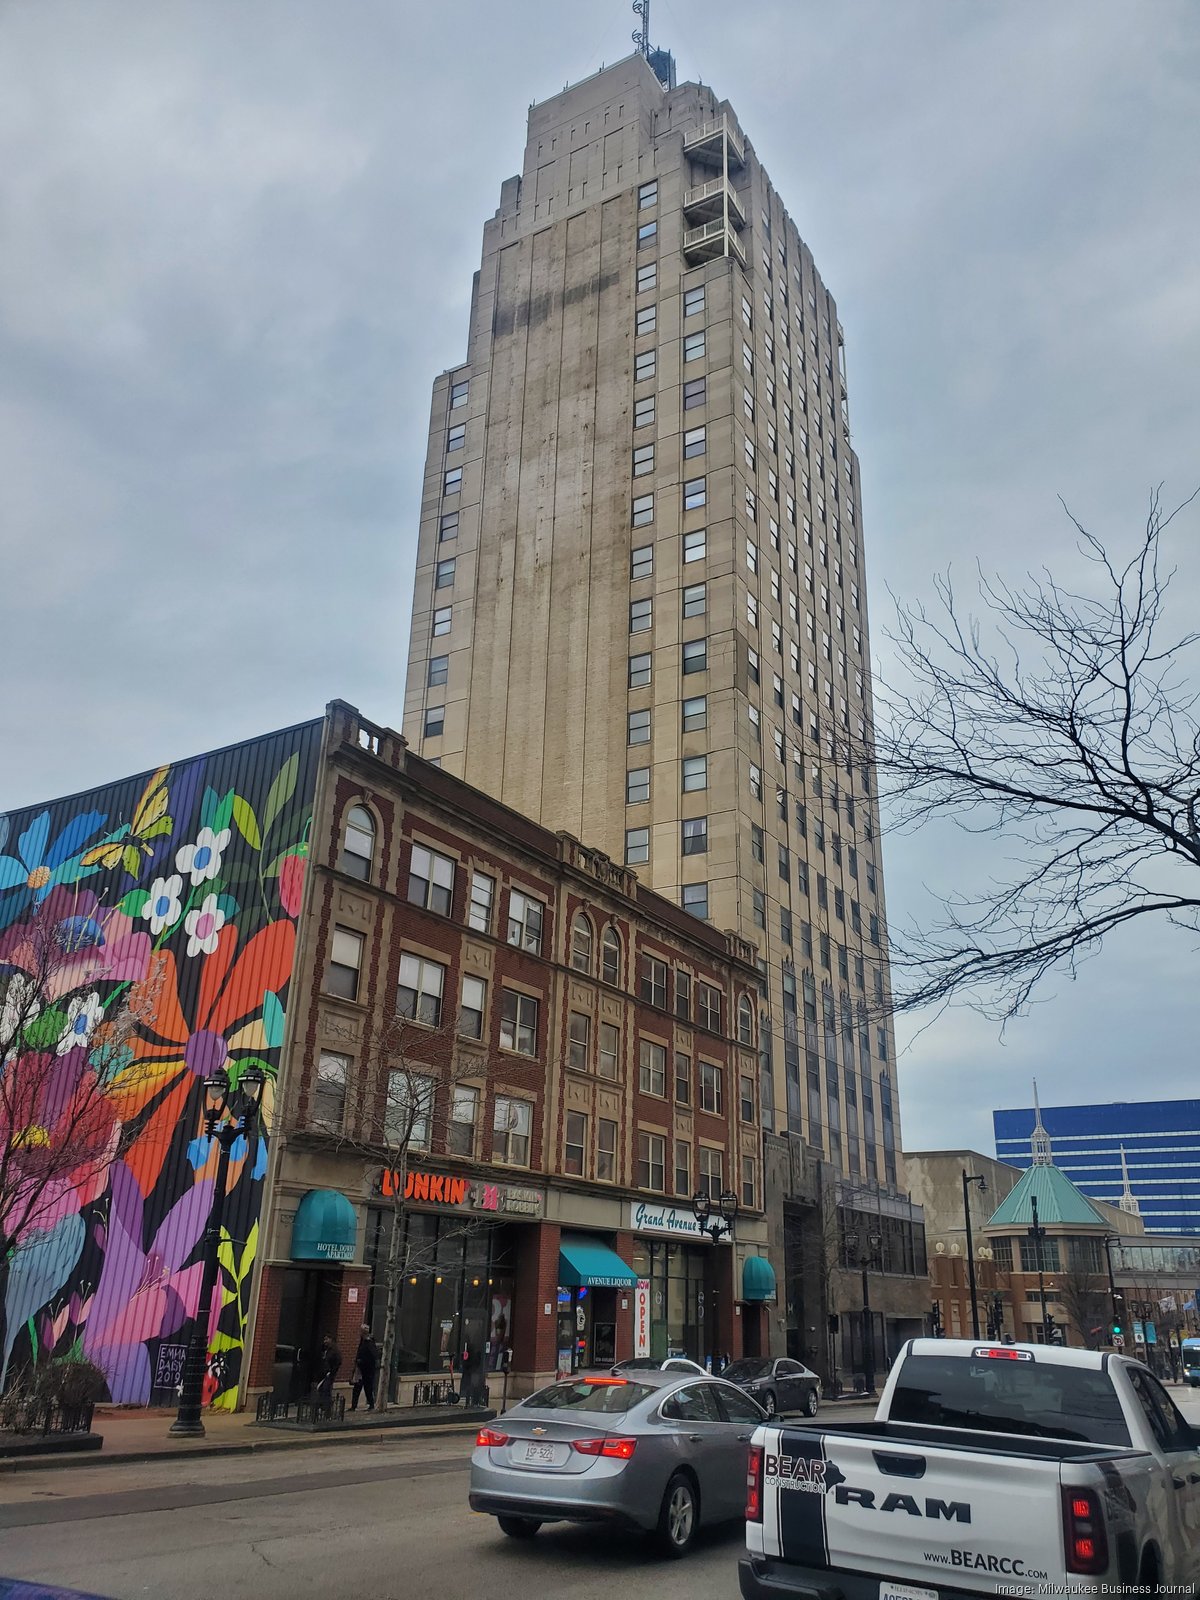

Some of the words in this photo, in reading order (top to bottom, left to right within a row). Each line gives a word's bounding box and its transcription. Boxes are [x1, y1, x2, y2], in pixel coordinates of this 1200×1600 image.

[635, 1203, 666, 1230] Grand
[667, 1209, 696, 1232] Avenue
[317, 1243, 339, 1251] HOTEL
[587, 1276, 611, 1286] AVENUE
[611, 1277, 632, 1288] LIQUOR
[638, 1292, 646, 1348] OPEN
[160, 1347, 186, 1360] EMMA
[158, 1358, 184, 1372] DAISY
[156, 1370, 181, 1384] 2019
[765, 1454, 825, 1484] BEAR
[765, 1476, 826, 1494] CONSTRUCTION
[835, 1485, 972, 1524] RAM
